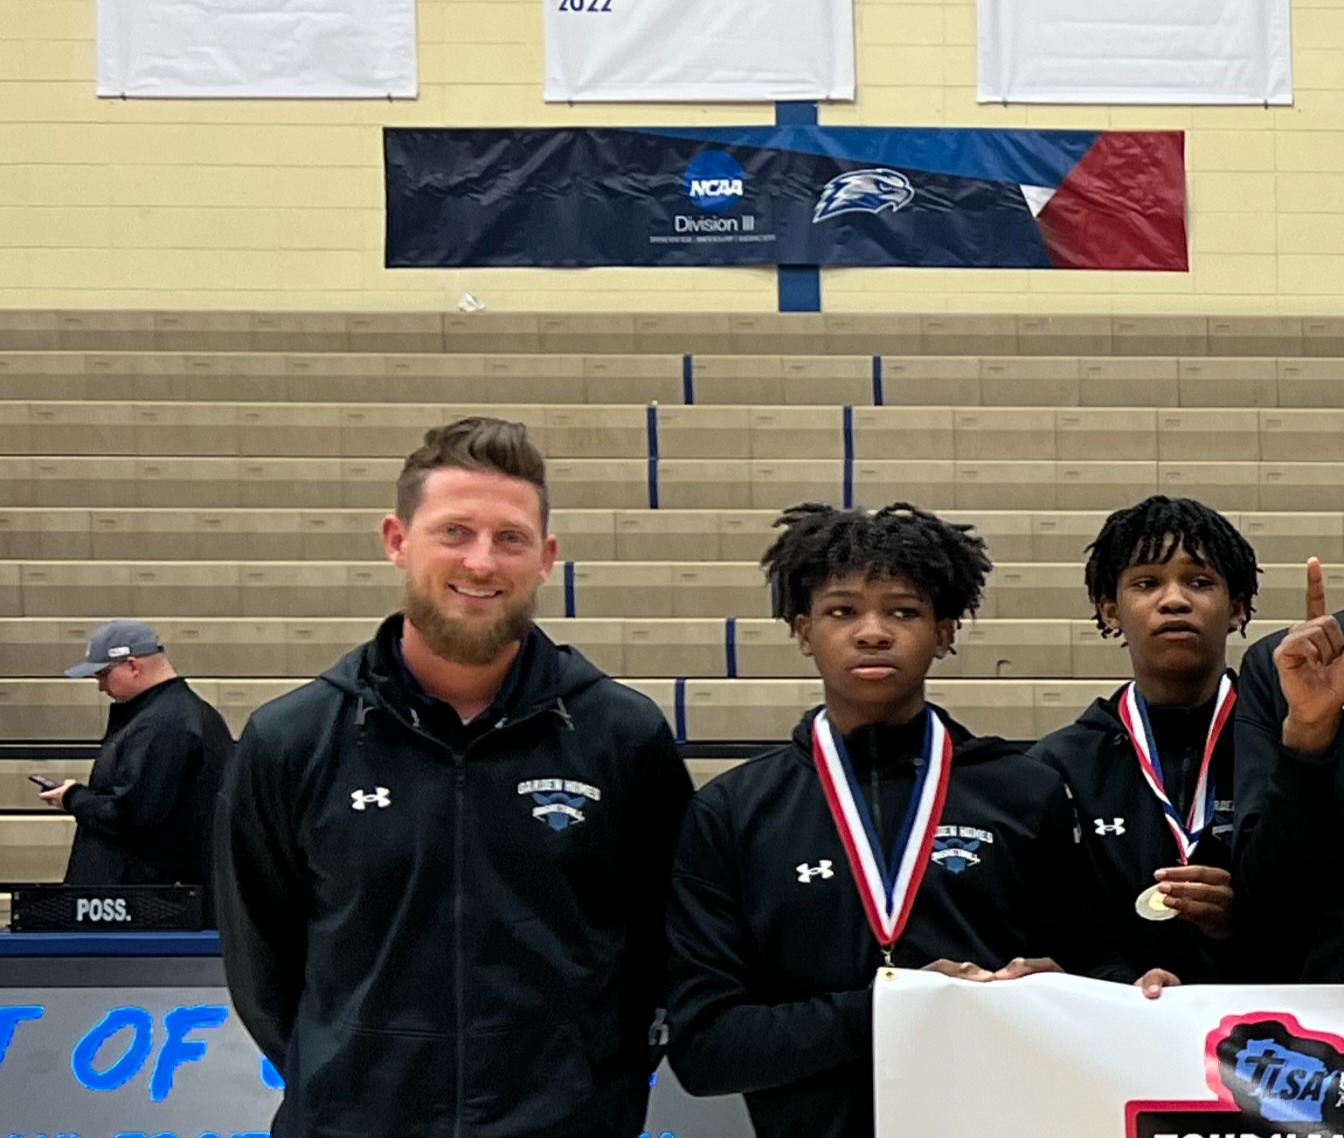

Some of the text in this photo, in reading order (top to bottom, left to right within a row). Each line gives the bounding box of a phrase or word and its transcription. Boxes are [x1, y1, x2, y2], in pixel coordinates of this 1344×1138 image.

[689, 179, 743, 197] NCAA
[674, 214, 738, 232] Division
[76, 898, 132, 922] POSS.
[71, 1004, 229, 1102] OF
[1263, 1067, 1325, 1101] LSA
